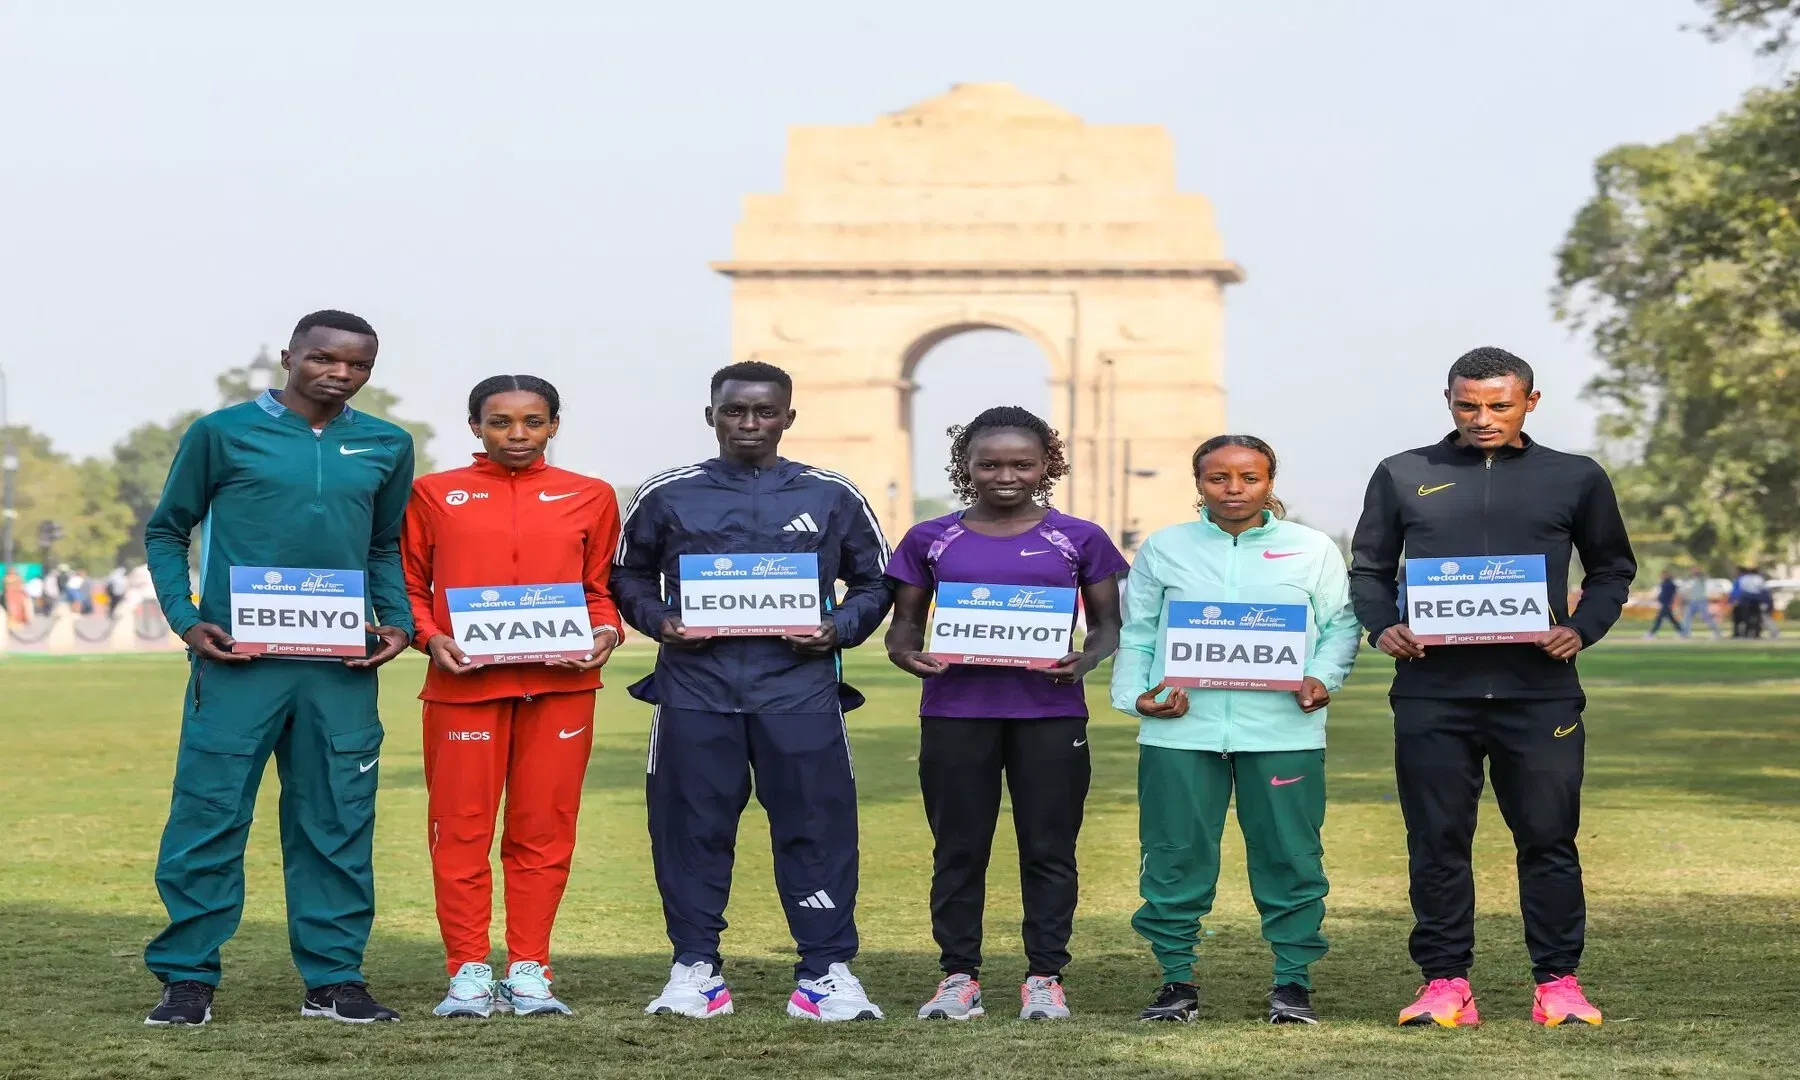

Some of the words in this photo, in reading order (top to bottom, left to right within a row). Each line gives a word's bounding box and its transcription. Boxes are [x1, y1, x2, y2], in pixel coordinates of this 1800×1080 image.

[753, 561, 780, 577] delhi
[1480, 565, 1508, 581] delhi
[302, 576, 329, 593] delhi
[1427, 574, 1474, 582] vedanta
[251, 583, 296, 591] vedanta
[469, 600, 515, 608] vedanta
[520, 591, 547, 606] delhi
[684, 594, 817, 610] LEONARD
[957, 599, 1003, 607] vedanta
[1009, 592, 1037, 608] delhi
[1414, 597, 1541, 619] REGASA
[238, 608, 359, 629] EBENYO
[1188, 618, 1235, 626] vedanta
[1241, 612, 1269, 628] delhi
[464, 619, 584, 642] AYANA
[936, 622, 1067, 642] CHERIYOT
[1171, 642, 1298, 665] DIBABA
[448, 731, 491, 740] INEOS
